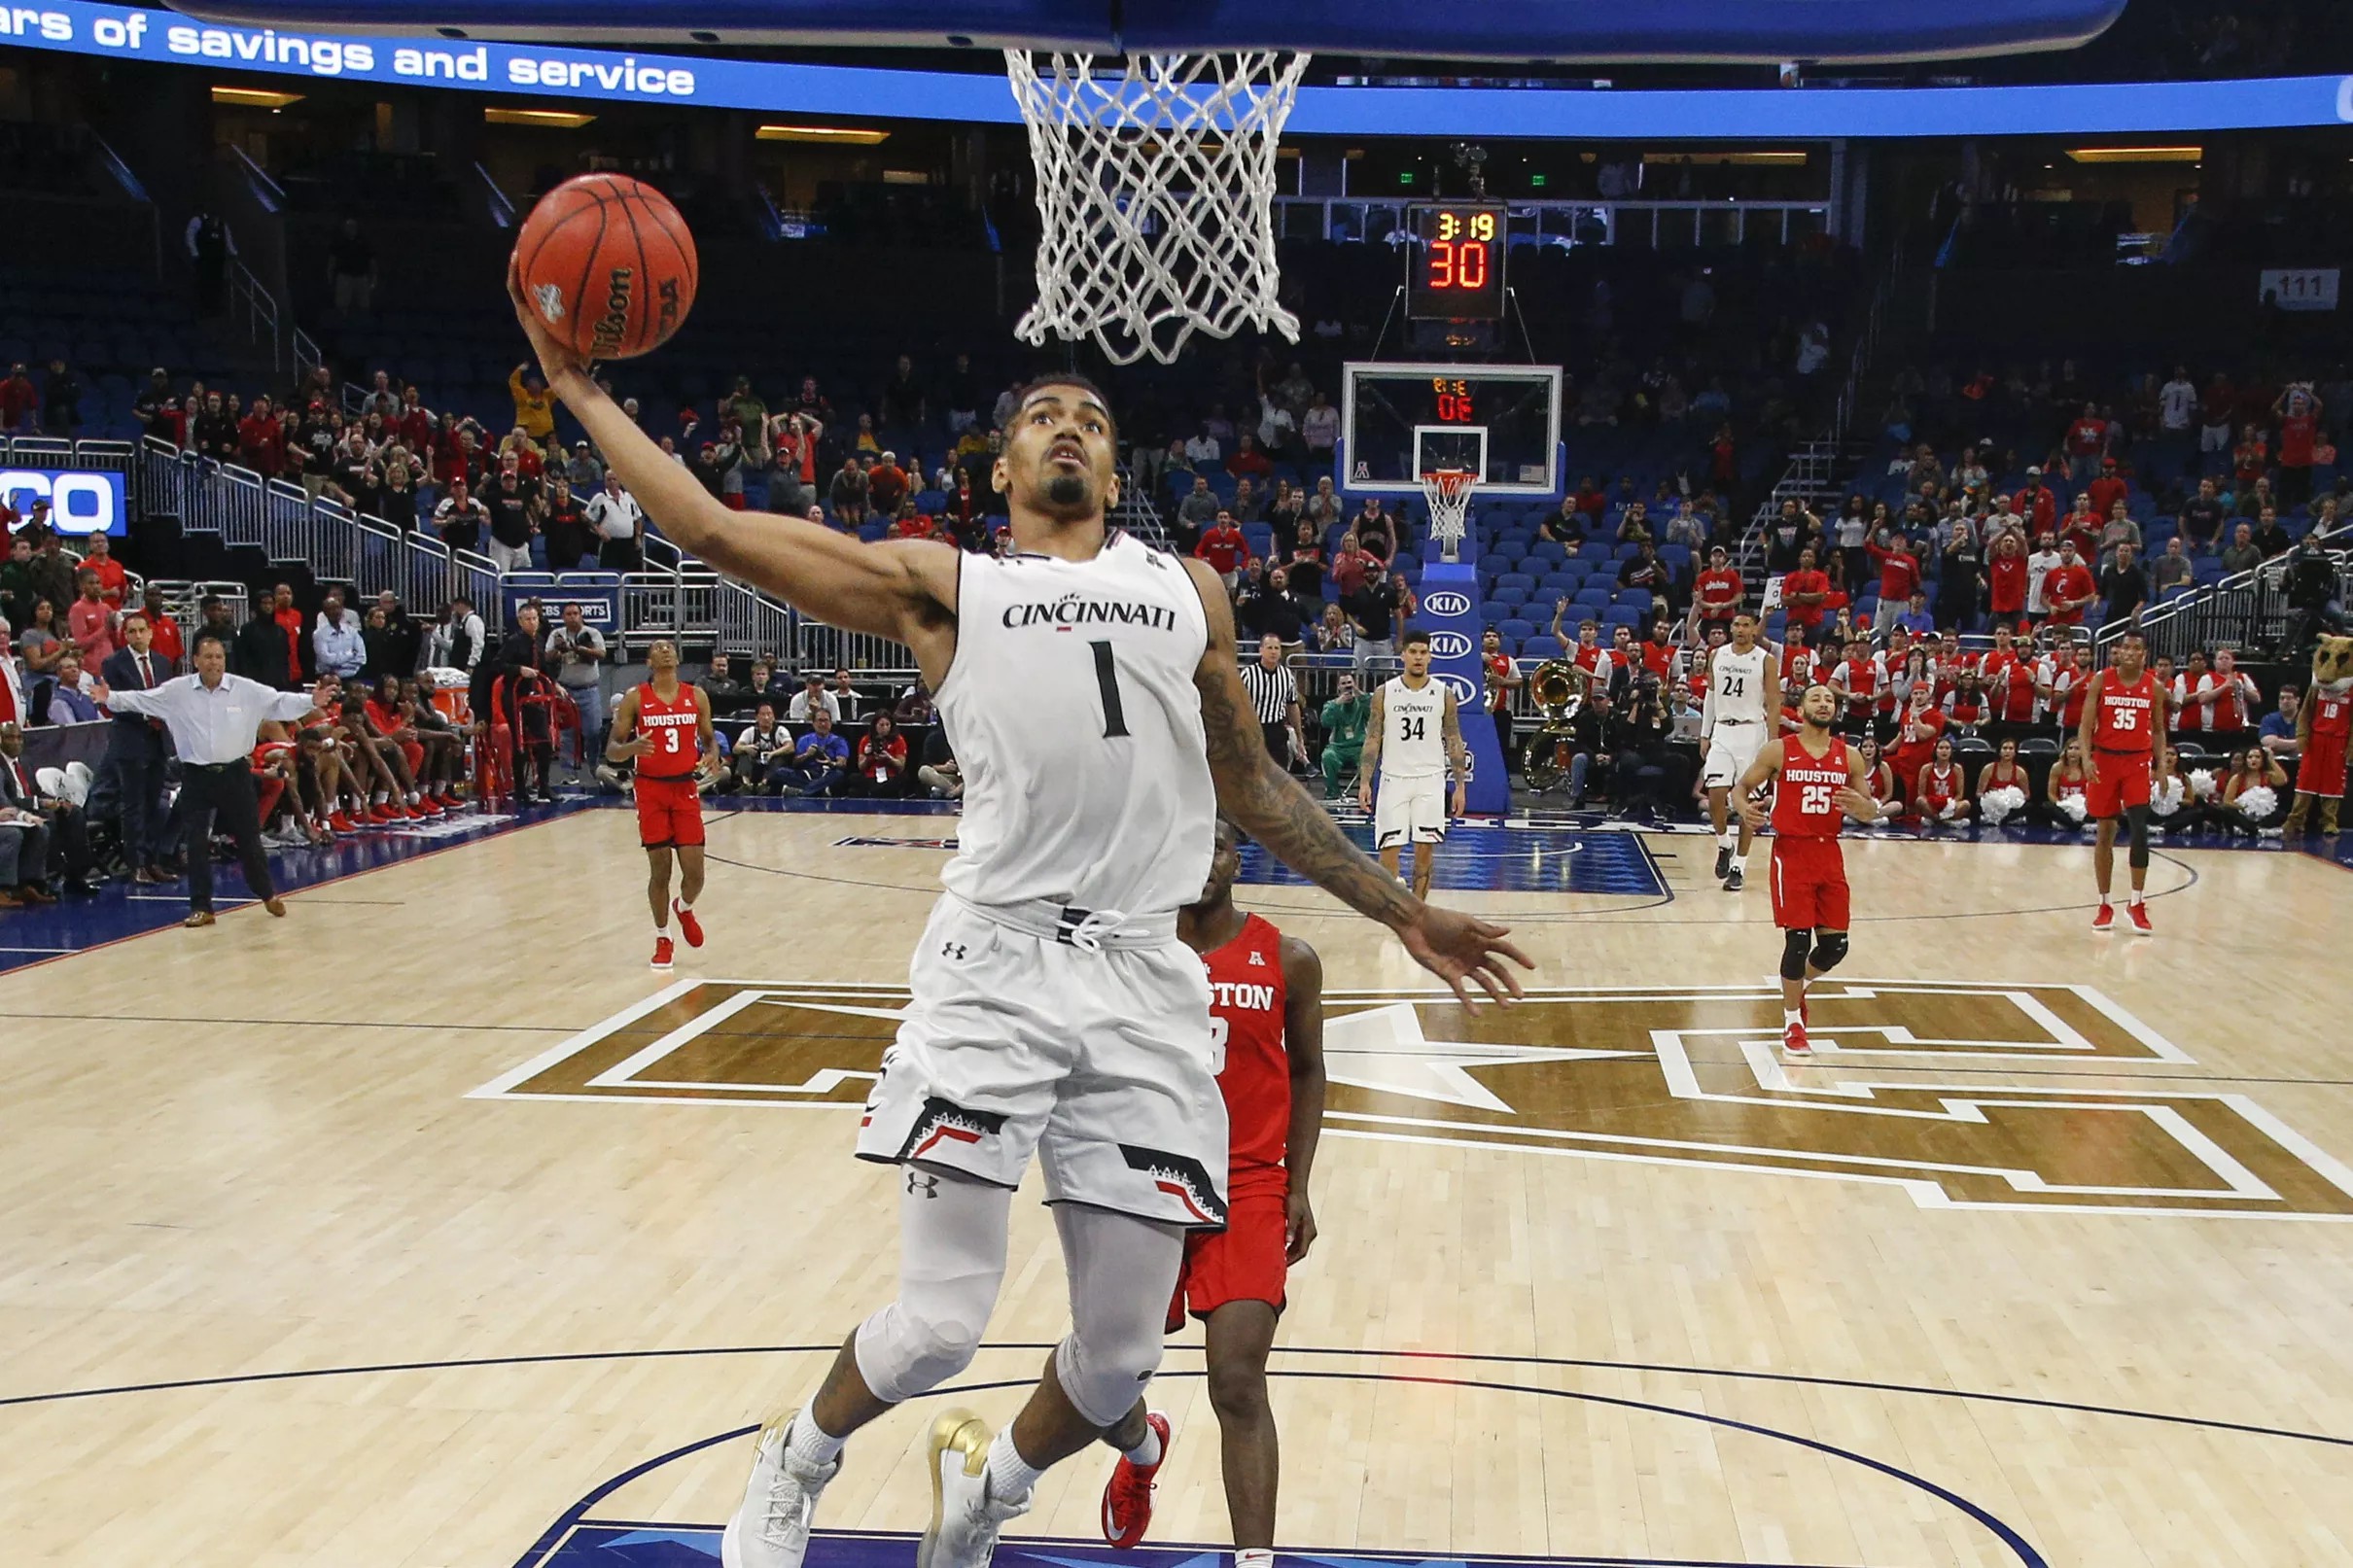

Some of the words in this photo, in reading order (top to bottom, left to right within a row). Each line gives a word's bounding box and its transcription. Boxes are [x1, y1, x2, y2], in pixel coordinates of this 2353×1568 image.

[94, 13, 147, 49] of
[167, 26, 374, 75] savings
[393, 47, 487, 81] and
[509, 56, 695, 95] service
[1439, 213, 1494, 242] 3:19
[1430, 242, 1484, 288] 30
[2278, 276, 2322, 296] 111
[1002, 593, 1176, 632] CINCINNATI
[1431, 597, 1463, 611] KIA
[1429, 637, 1463, 653] KIA
[1089, 640, 1131, 738] 1
[1722, 676, 1744, 698] 24
[2104, 695, 2150, 709] HOUSTON
[643, 714, 697, 727] HOUSTON
[1400, 716, 1424, 741] 34
[2113, 708, 2137, 730] 35
[664, 728, 679, 753] 3
[1785, 769, 1847, 785] HOUSTON
[1801, 785, 1833, 815] 25
